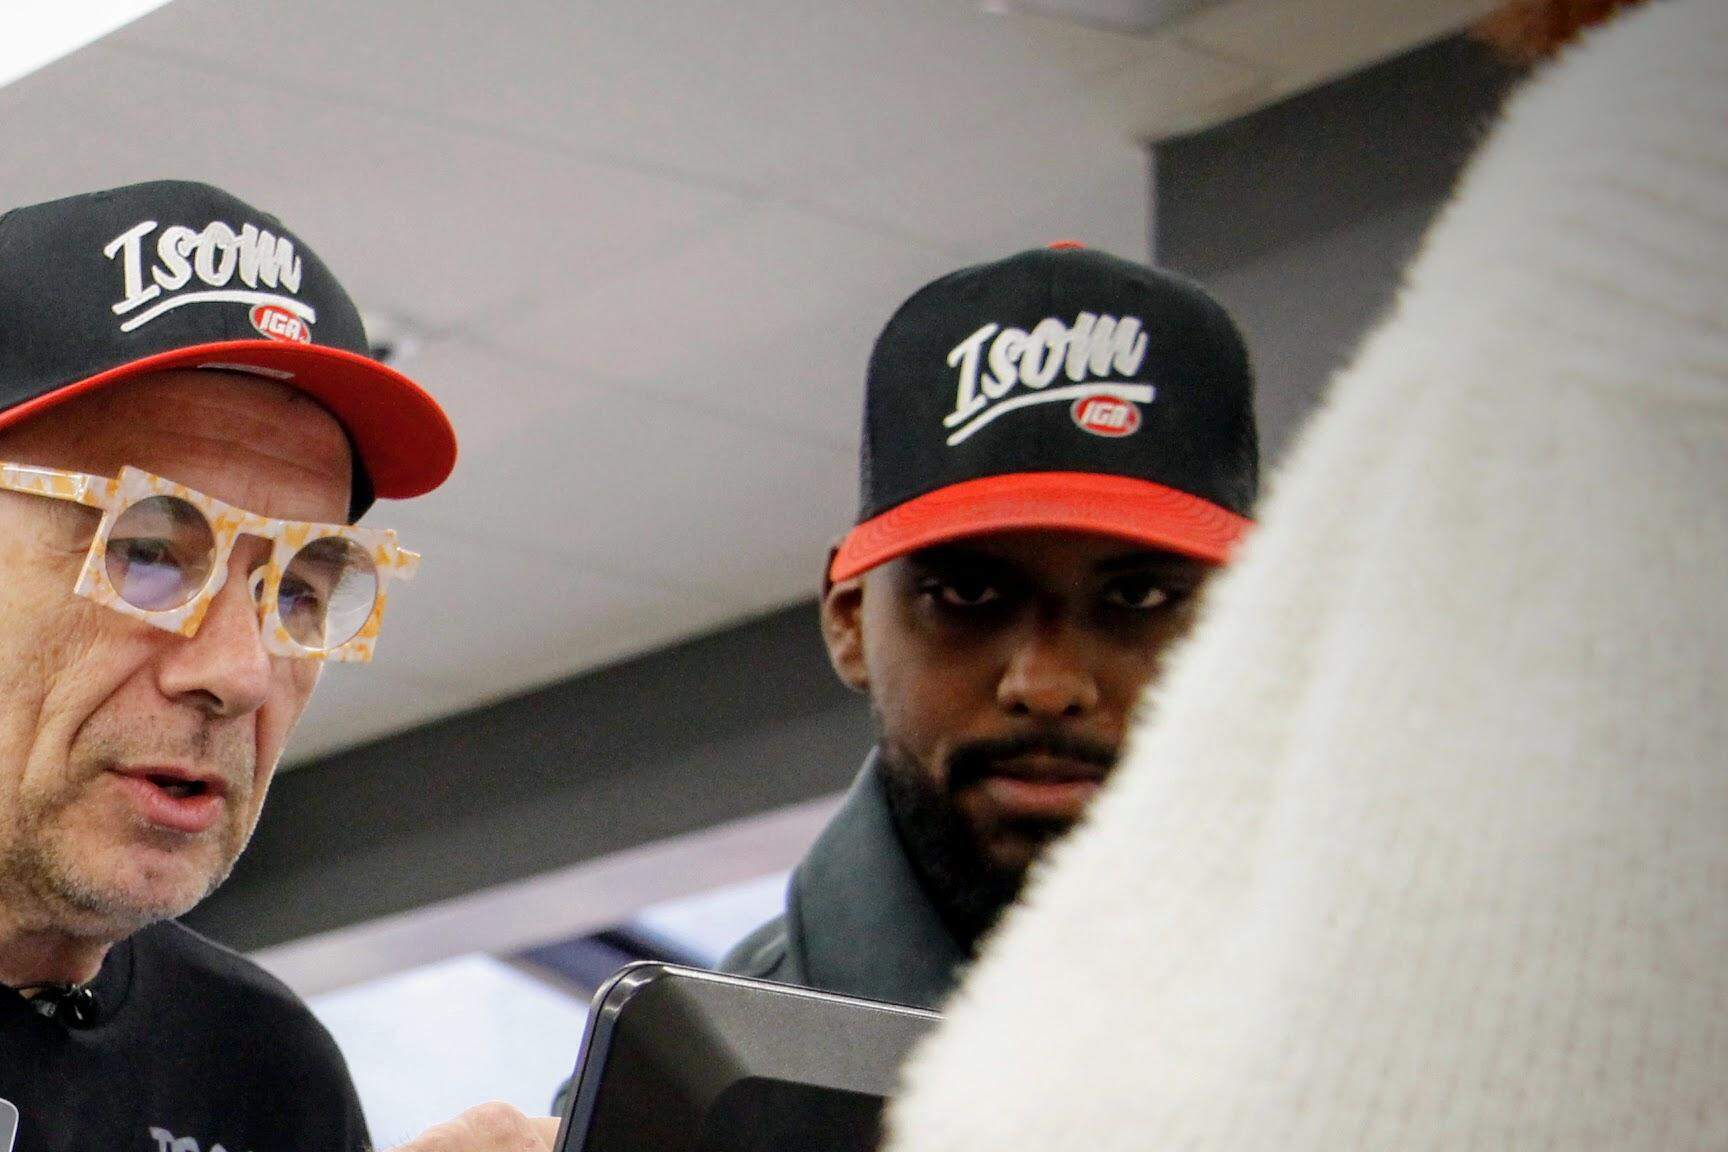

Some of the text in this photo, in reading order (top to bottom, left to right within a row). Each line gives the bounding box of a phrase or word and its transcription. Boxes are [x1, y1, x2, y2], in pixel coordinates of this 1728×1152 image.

[103, 220, 302, 315] Isom
[259, 309, 302, 341] IGA
[942, 311, 1149, 428] Isom
[1080, 401, 1128, 427] IGA
